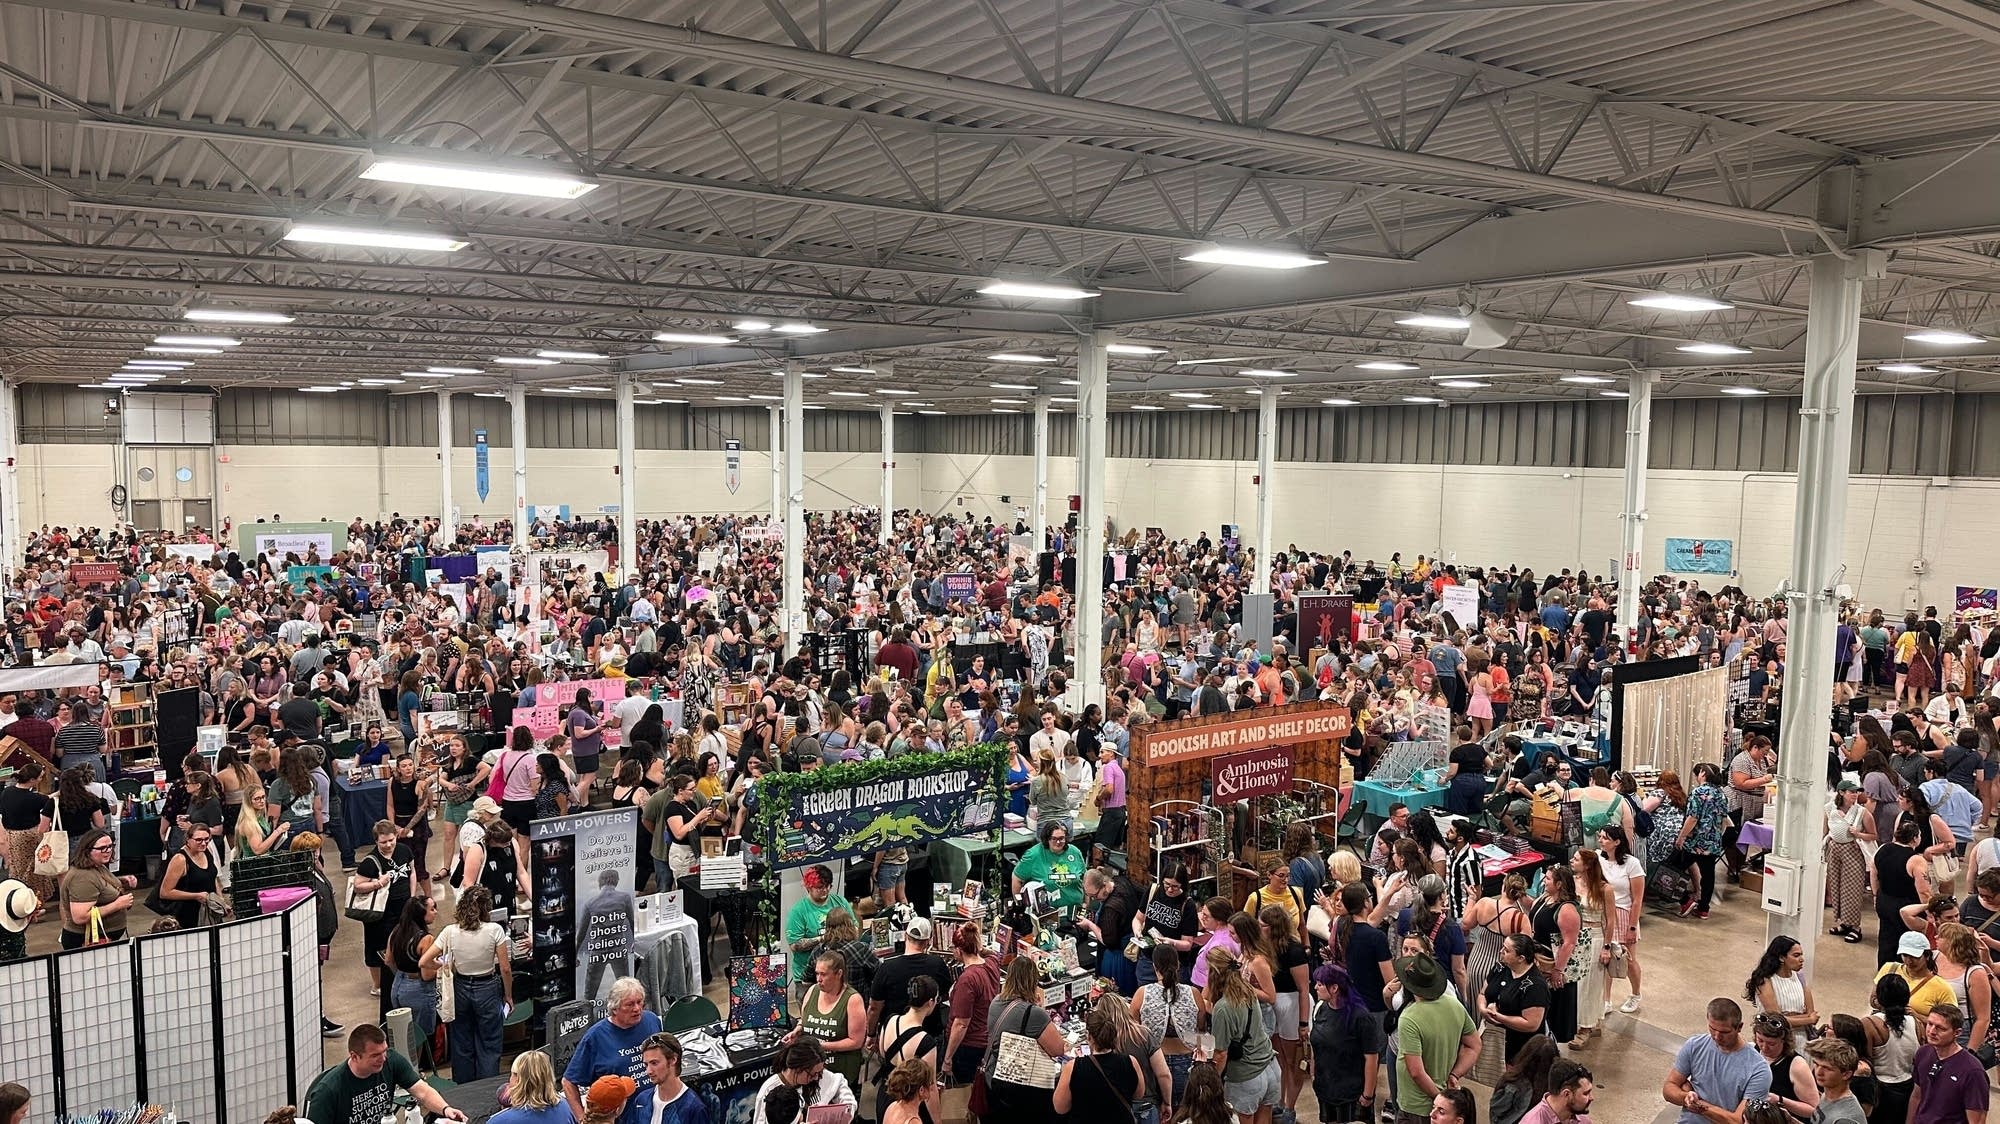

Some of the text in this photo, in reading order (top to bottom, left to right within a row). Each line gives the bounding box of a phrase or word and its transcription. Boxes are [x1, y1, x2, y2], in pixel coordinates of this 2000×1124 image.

[1303, 599, 1349, 609] E.H. DRAKE
[588, 680, 622, 688] STREET
[1150, 715, 1347, 759] BOOKISH ART AND SHELF DECOR
[1226, 753, 1289, 779] Ambrosia
[855, 780, 904, 808] DRAGON
[907, 770, 970, 800] BOOKSHOP
[1216, 768, 1280, 797] & Honey
[540, 811, 632, 836] A.W. POWERS
[587, 832, 628, 847] Do you
[580, 844, 634, 861] believe in
[584, 857, 630, 874] ghosts?
[591, 911, 627, 925] Do the
[1147, 901, 1181, 920] STAR
[1147, 911, 1181, 929] WARS
[589, 924, 628, 940] ghosts
[587, 937, 627, 951] believe
[589, 949, 628, 963] in you?
[807, 1014, 838, 1026] You're in
[803, 1027, 836, 1037] my dad's
[715, 1066, 774, 1091] A.W. POWE
[352, 1082, 388, 1106] HERE TO
[352, 1090, 390, 1115] SUPPORT
[349, 1112, 364, 1124] MY
